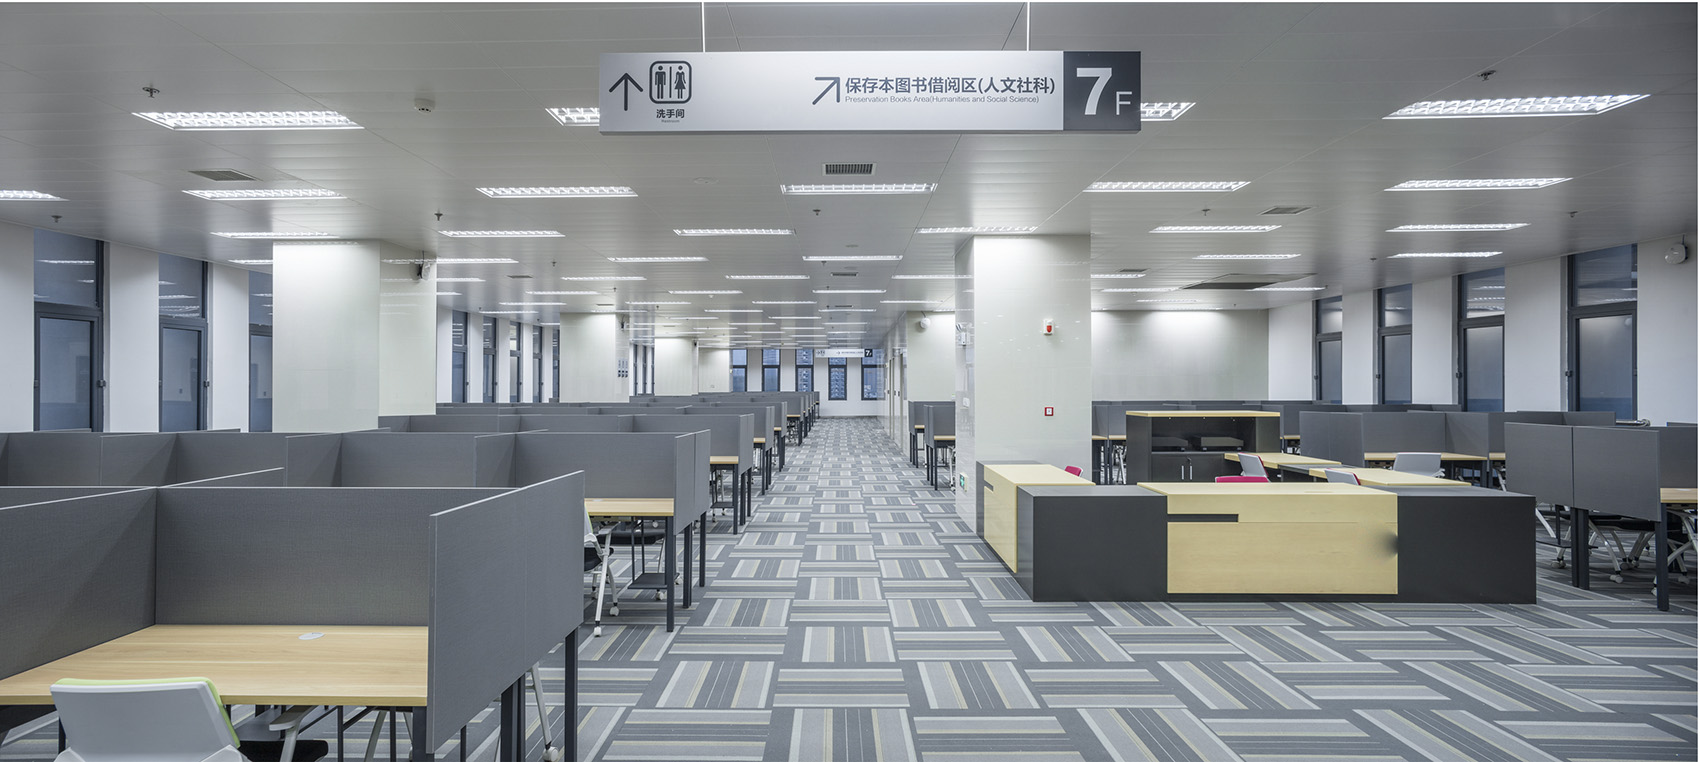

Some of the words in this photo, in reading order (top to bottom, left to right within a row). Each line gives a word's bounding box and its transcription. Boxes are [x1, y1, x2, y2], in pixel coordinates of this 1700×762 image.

[845, 77, 1055, 94] 保存本图书借阅区(人文社科)
[656, 108, 685, 119] 洗手间
